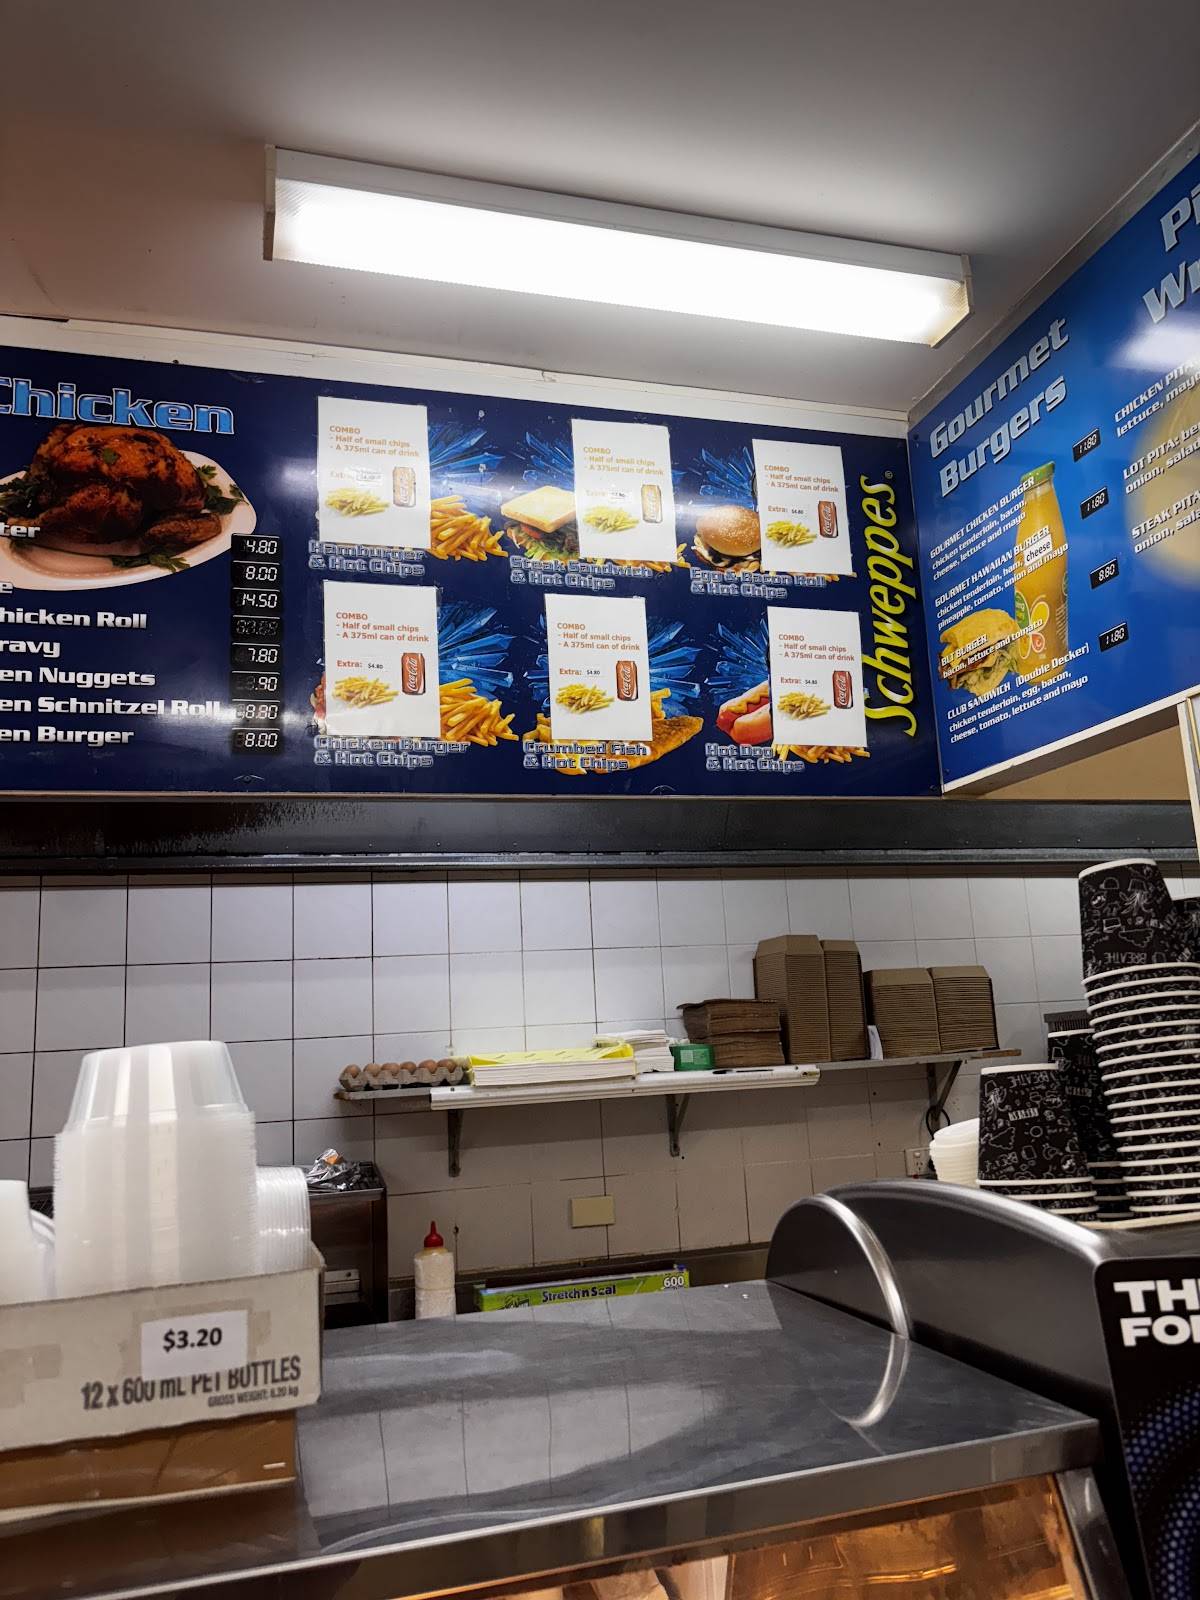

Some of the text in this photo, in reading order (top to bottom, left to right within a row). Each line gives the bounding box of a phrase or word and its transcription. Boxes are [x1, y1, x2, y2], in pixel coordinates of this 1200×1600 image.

[929, 318, 1069, 458] Gourmet
[1115, 379, 1164, 423] CHICKEN
[1116, 401, 1164, 438] lettuce,
[329, 426, 361, 434] COMBO
[939, 375, 1067, 497] Burgers
[389, 440, 410, 448] chips
[764, 465, 790, 473] COMBO
[1123, 457, 1145, 480] LOT
[821, 484, 839, 493] drink
[1125, 466, 1165, 494] onion,
[930, 476, 1035, 559] GOURMET CHICKEN BURGER
[1131, 508, 1172, 539] STEAK
[932, 547, 959, 570] chicken
[1000, 500, 1027, 521] bacon,
[1134, 526, 1175, 554] onion,
[245, 540, 278, 554] 4.80
[933, 511, 1026, 580] cheese, lettuce and mayo
[308, 554, 425, 578] & Hot Chips
[509, 555, 565, 572] Steak
[245, 566, 278, 581] 8.00
[510, 569, 616, 591] & Hot Chips
[934, 577, 970, 607] GOURMET
[971, 549, 1014, 583] HAWAIIAN
[936, 598, 963, 618] chicken
[1026, 541, 1051, 562] cheese
[690, 581, 787, 600] & Hot Chips
[937, 603, 974, 631] pineapple,
[1004, 569, 1027, 587] onion
[1027, 557, 1044, 575] and
[1044, 543, 1069, 565] mayo
[242, 593, 278, 608] 14.50
[860, 474, 917, 737] Schweppes
[97, 612, 147, 629] Roll
[335, 612, 368, 620] COMBO
[342, 622, 360, 630] Half
[397, 625, 419, 633] chips
[351, 632, 378, 640] 375ml
[407, 634, 429, 642] drink
[611, 634, 631, 642] chips
[620, 643, 640, 651] drink
[778, 634, 805, 642] COMBO
[967, 647, 995, 666] lettuce
[994, 638, 1011, 653] and
[1011, 618, 1043, 643] tomato
[248, 648, 278, 663] 7.80
[791, 652, 813, 660] 375ml
[836, 654, 855, 662] drink
[808, 644, 826, 652] small
[828, 645, 847, 653] chips
[941, 634, 988, 667] BLT BURGER
[337, 660, 362, 668] Extra:
[39, 667, 156, 689] Nuggets
[947, 642, 1090, 720] CLUB SANDWICH (Double Decker)
[38, 697, 165, 714] Schnitzel
[171, 699, 220, 715] Roll
[949, 715, 977, 733] chicken
[1041, 672, 1072, 688] bacon,
[950, 675, 1089, 744] cheese, tomato, lettuce and mayo
[37, 726, 134, 747] Burger
[244, 733, 278, 747] 8.00
[313, 735, 471, 754] Chicken Burger
[522, 741, 648, 756] Crumbed Fish
[705, 743, 773, 759] Hot Dog
[314, 751, 433, 769] & Hot Chips
[523, 754, 629, 771] & Hot Chips
[705, 757, 805, 774] & Hot Chips
[663, 1275, 684, 1288] 600
[163, 1327, 223, 1352] $3.20
[81, 1380, 104, 1411] 12
[106, 1384, 119, 1407] x
[122, 1376, 155, 1405] 600
